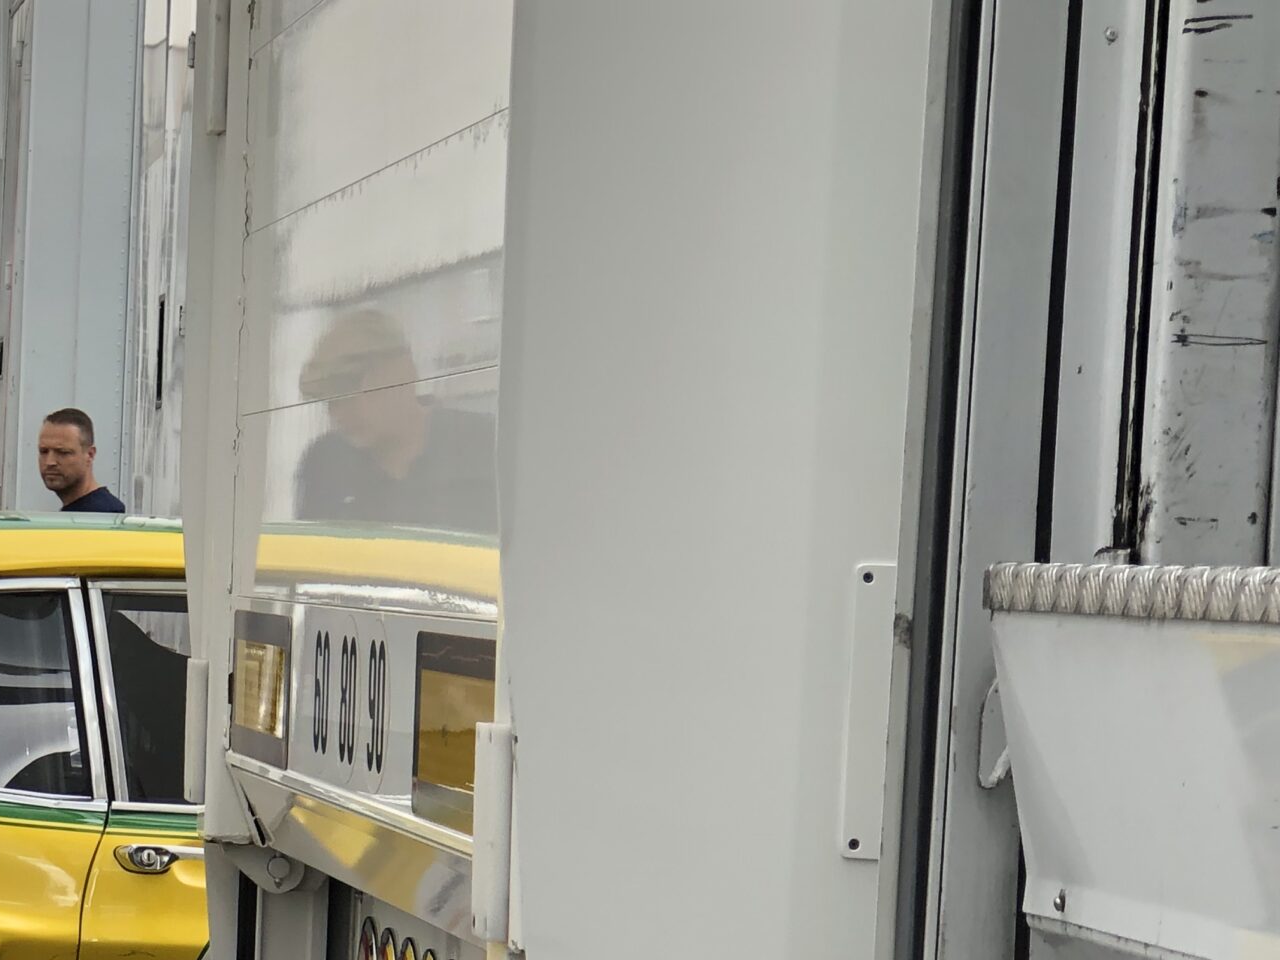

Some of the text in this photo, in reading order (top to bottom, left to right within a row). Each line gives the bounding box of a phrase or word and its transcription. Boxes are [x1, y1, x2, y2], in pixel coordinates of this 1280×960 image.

[313, 630, 386, 774] 60 80 90
